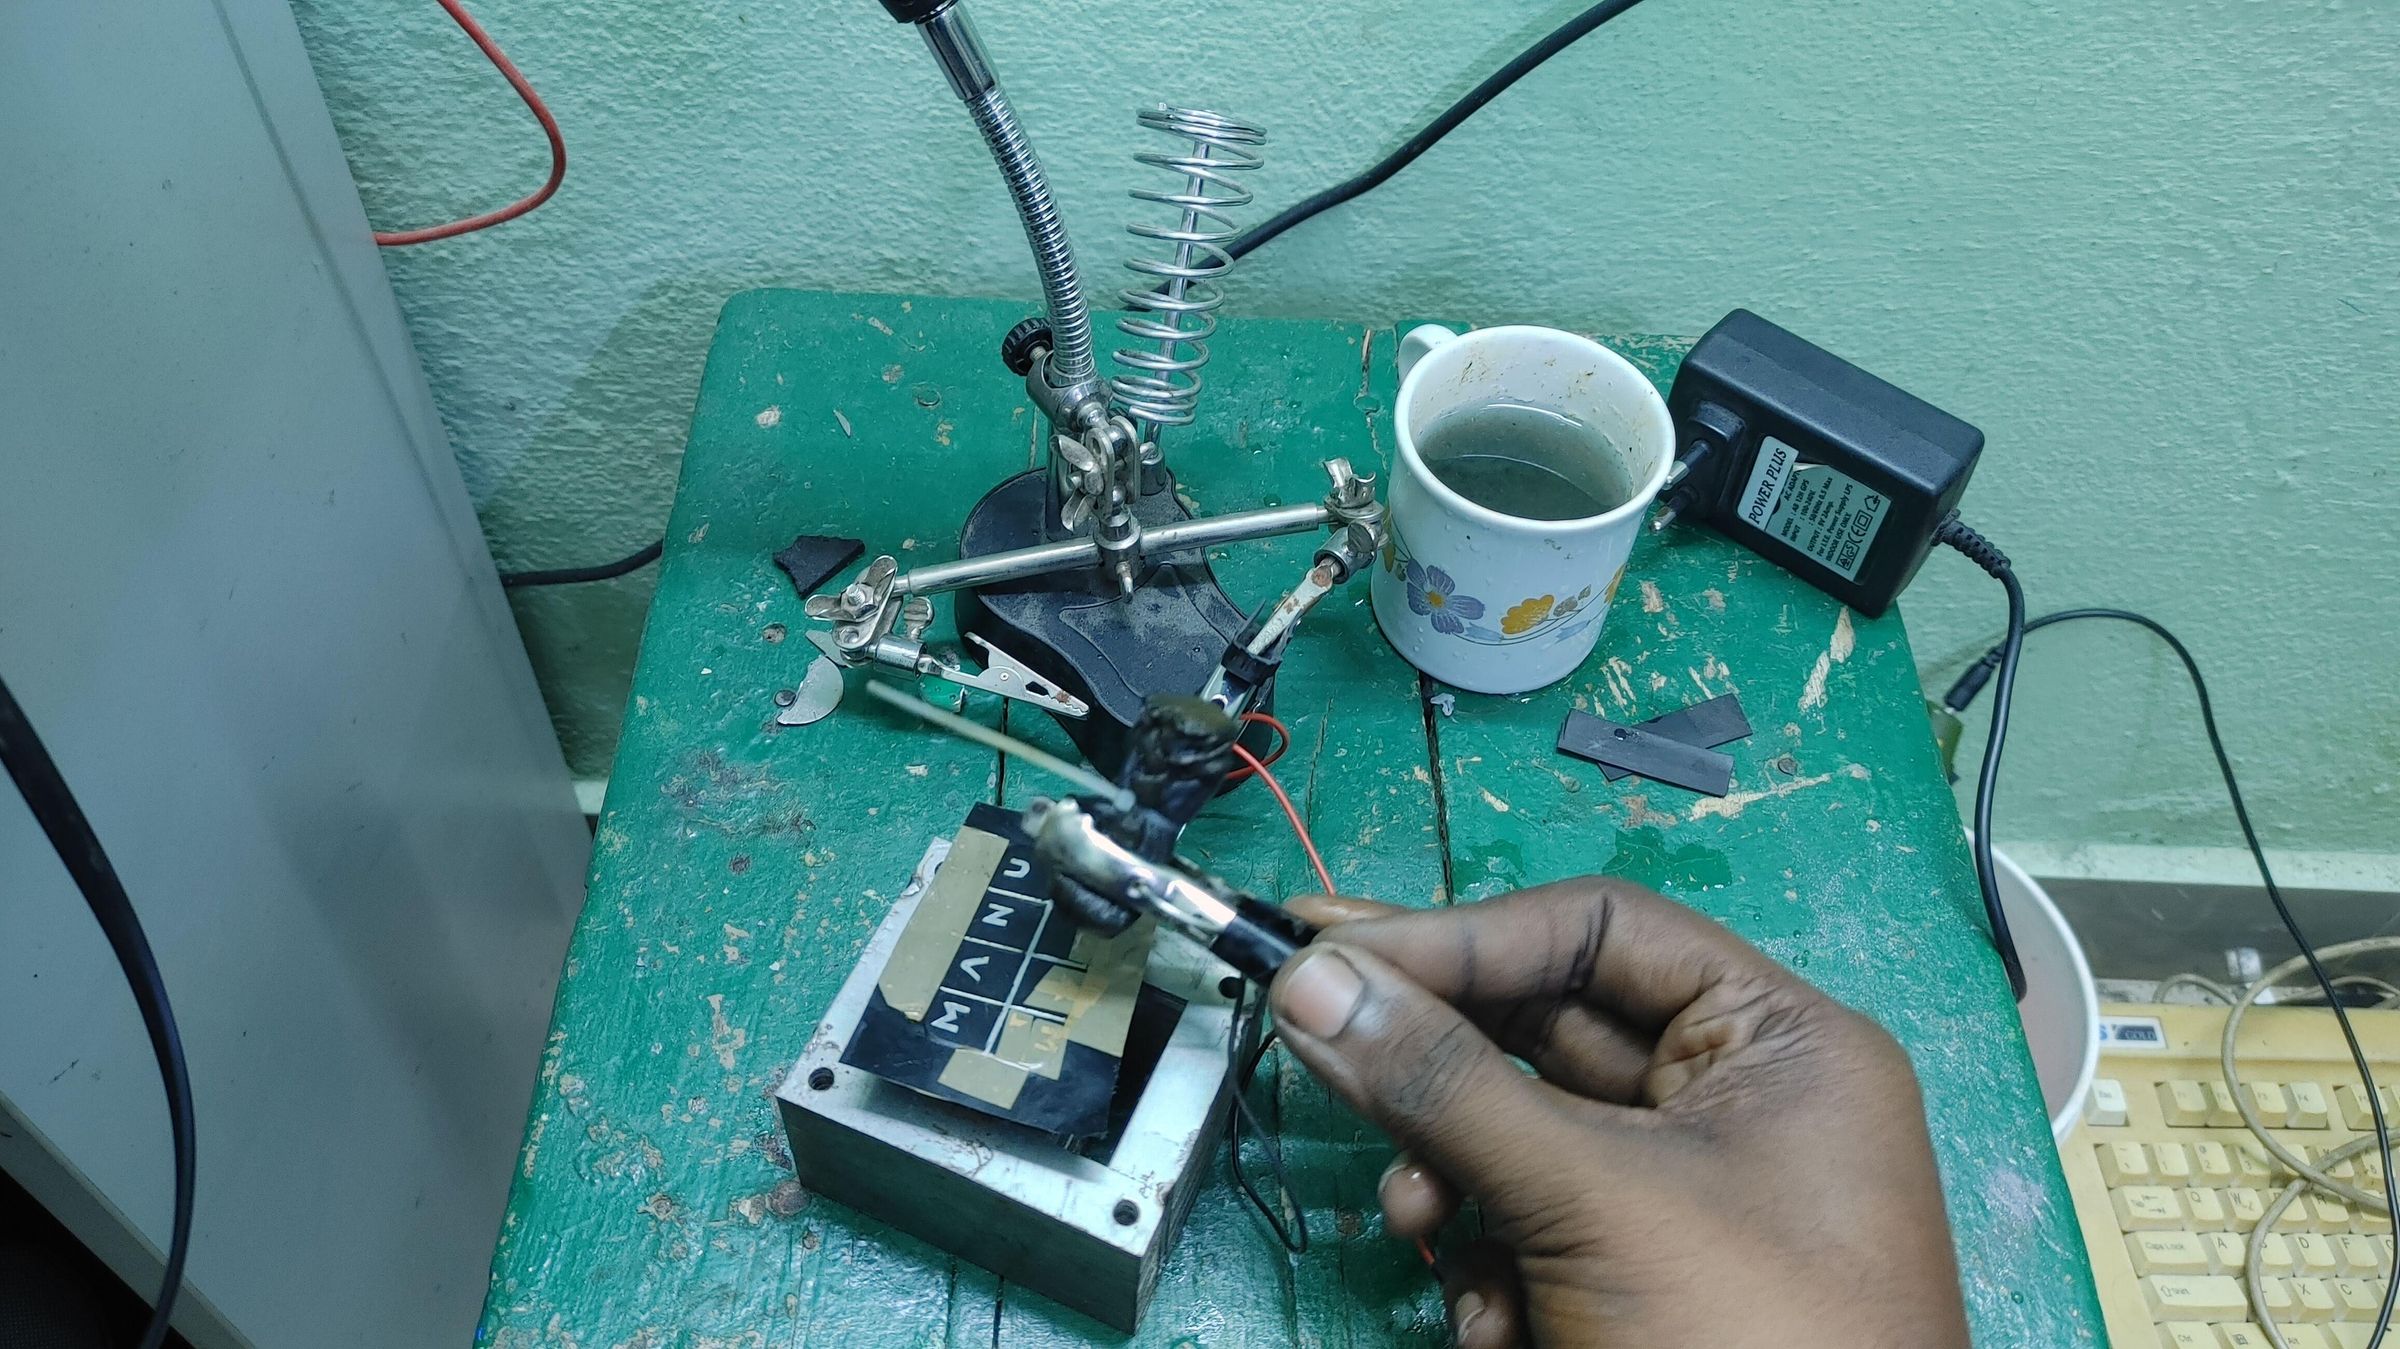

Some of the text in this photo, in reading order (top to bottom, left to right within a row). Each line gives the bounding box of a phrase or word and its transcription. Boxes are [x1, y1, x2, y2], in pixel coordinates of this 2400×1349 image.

[1748, 447, 1787, 525] POWER PLUS
[1800, 479, 1809, 491] GPS
[1827, 515, 1839, 534] Power
[1835, 495, 1849, 516] Supply
[1843, 483, 1853, 495] LPS
[1807, 529, 1820, 551] OUTPUT
[1835, 528, 1845, 540] USE
